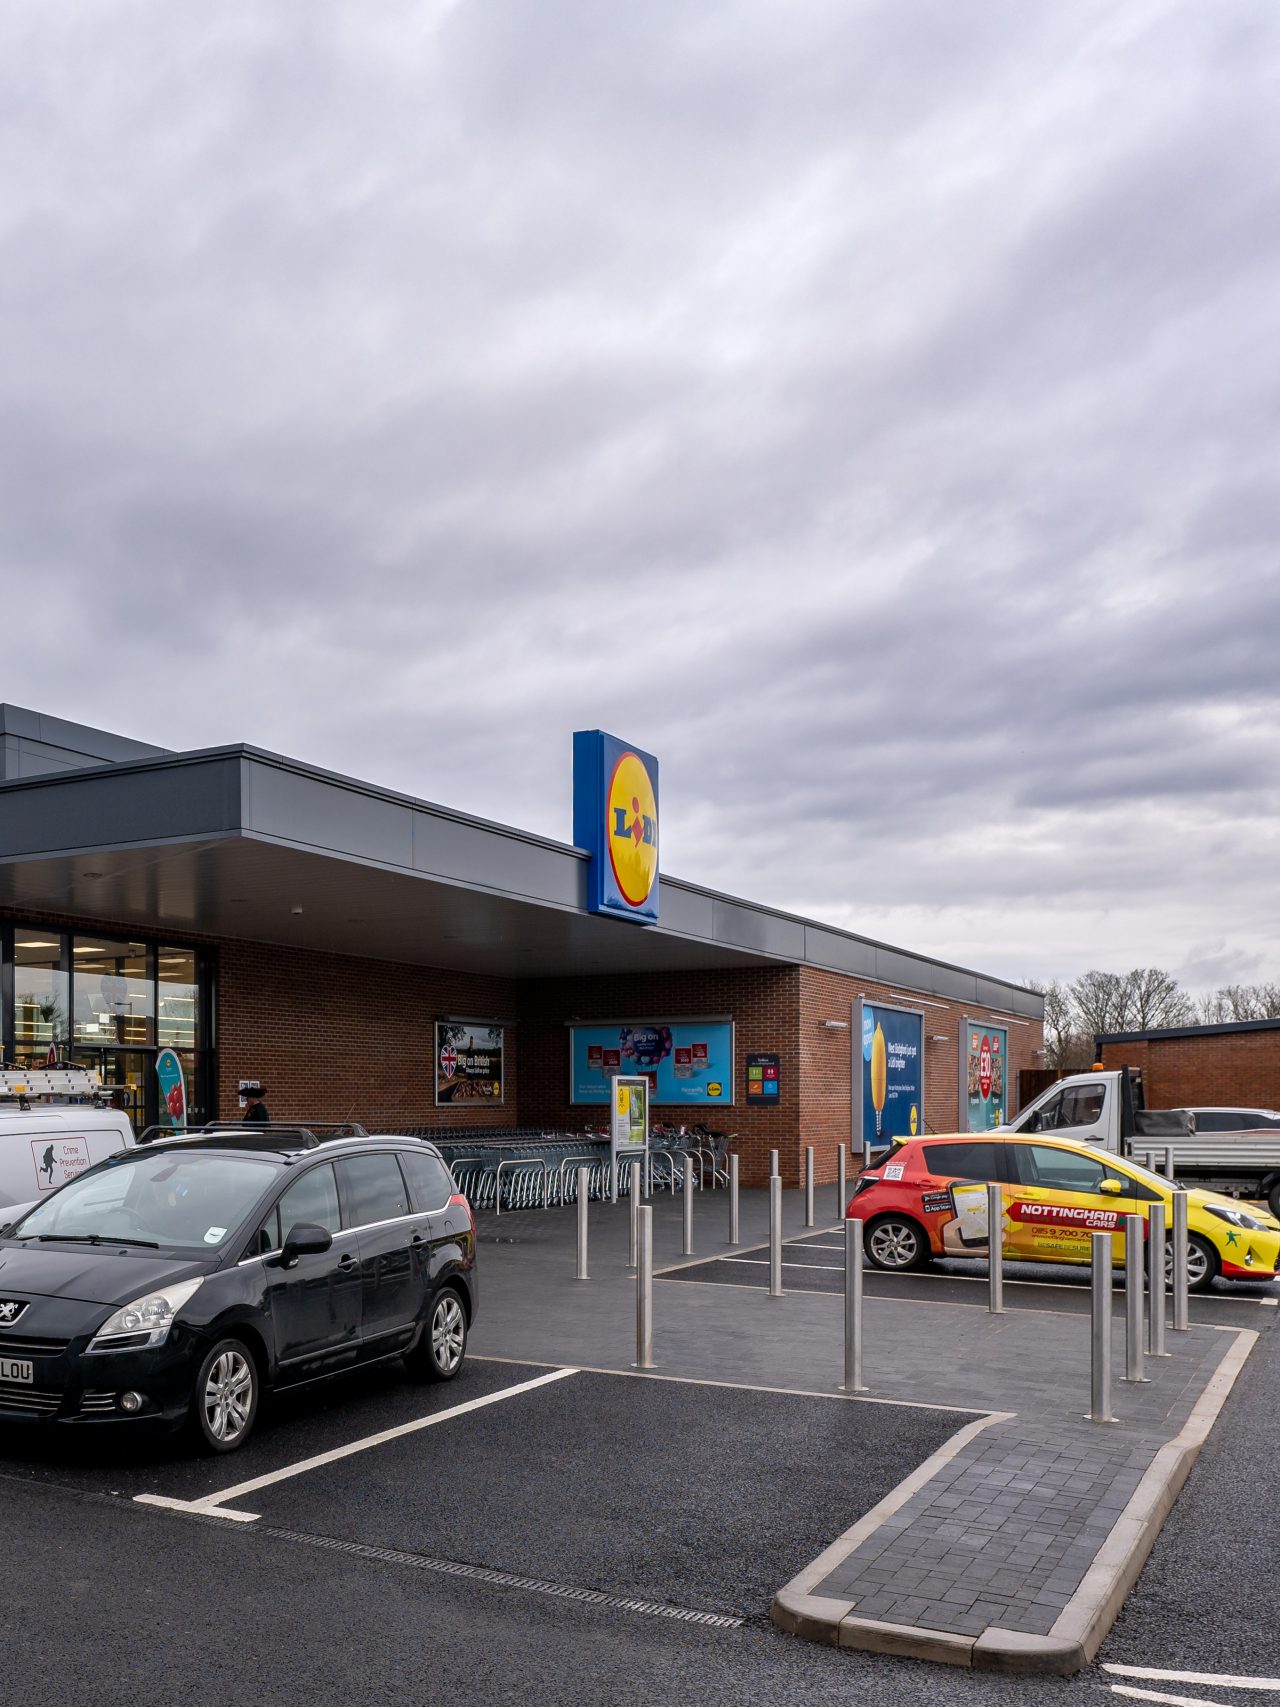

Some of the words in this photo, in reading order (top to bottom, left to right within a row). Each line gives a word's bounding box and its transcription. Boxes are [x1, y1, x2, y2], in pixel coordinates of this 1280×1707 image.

[633, 1032, 647, 1042] Big
[648, 1033, 659, 1041] on
[457, 1054, 467, 1069] Big
[467, 1057, 474, 1067] on
[474, 1055, 490, 1067] British
[63, 1145, 79, 1155] Crime
[59, 1157, 87, 1168] Prevention
[1020, 1204, 1118, 1221] NOTTINGHAM
[1085, 1219, 1115, 1228] CARS
[1049, 1227, 1056, 1236] 9
[1059, 1228, 1078, 1237] 700
[1080, 1230, 1093, 1239] 70
[1, 1361, 30, 1380] LOU
